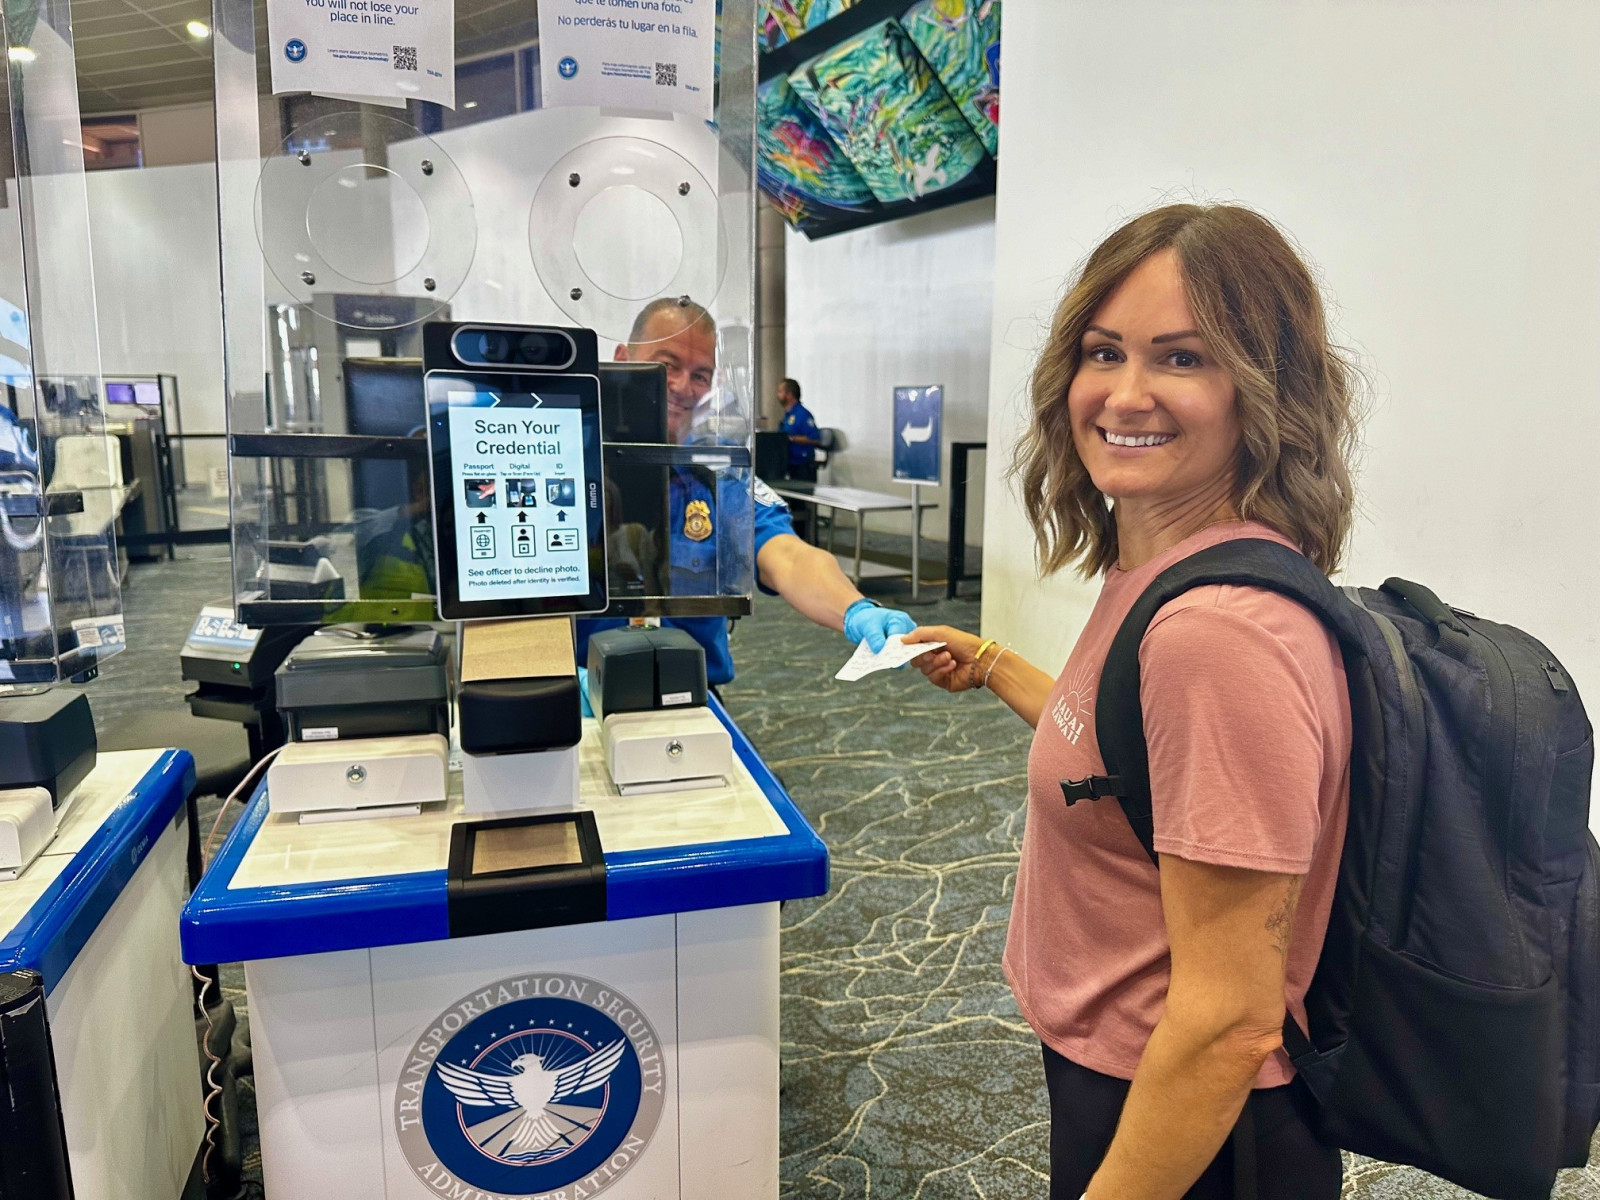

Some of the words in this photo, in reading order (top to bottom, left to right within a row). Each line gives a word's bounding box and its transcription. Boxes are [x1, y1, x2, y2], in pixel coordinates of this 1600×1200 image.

[328, 0, 347, 9] will
[350, 1, 368, 11] not
[370, 1, 392, 12] lose
[394, 4, 419, 15] your
[608, 0, 639, 8] tomen
[641, 1, 659, 10] una
[661, 1, 682, 13] foto.
[330, 11, 358, 22] place
[361, 12, 371, 23] in
[374, 13, 396, 26] line.
[557, 16, 572, 25] No
[574, 15, 617, 28] perderás
[619, 19, 629, 29] tu
[631, 20, 655, 32] lugar
[658, 24, 670, 33] en
[672, 24, 681, 34] la
[682, 25, 698, 38] fila.
[474, 419, 517, 434] Scan
[522, 420, 560, 434] Your
[476, 440, 561, 454] Credential
[468, 568, 484, 577] See
[486, 567, 512, 576] officer
[514, 567, 523, 575] to
[524, 565, 553, 574] decline
[555, 565, 580, 574] photo.
[527, 577, 550, 585] identity
[399, 976, 590, 1131] TRANSPORTATION
[592, 989, 663, 1095] SECURITY
[417, 1133, 646, 1200] ADMIRATION
